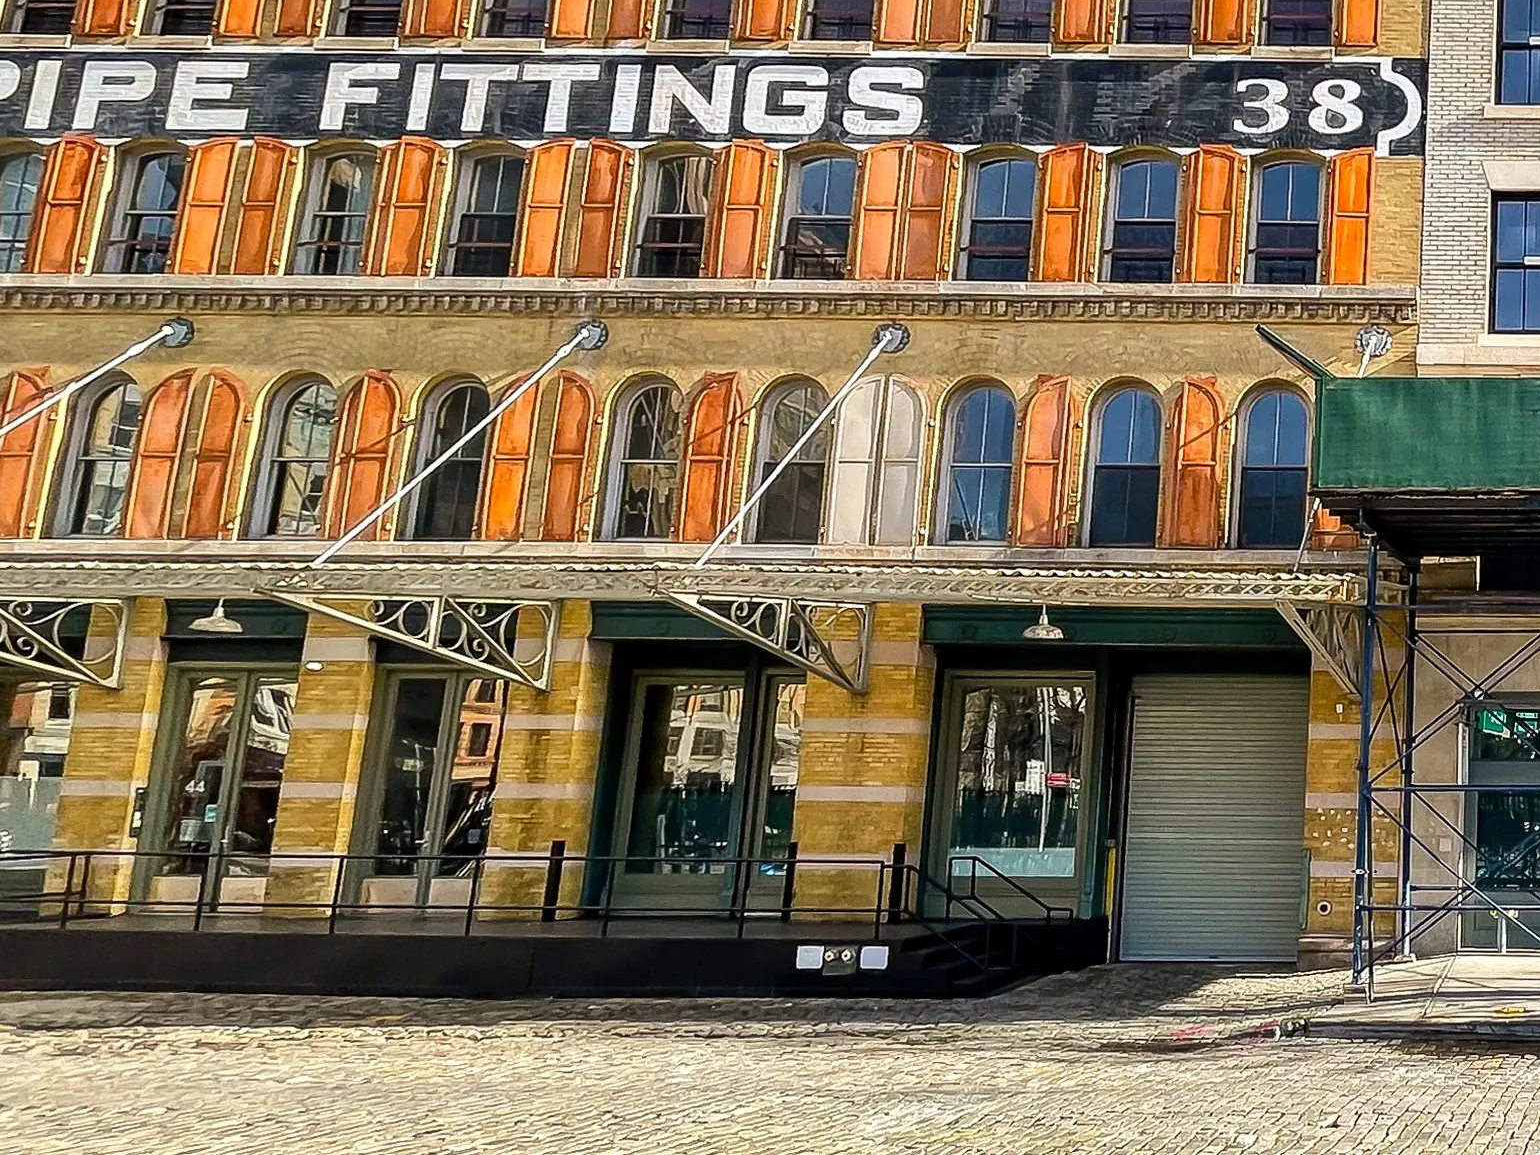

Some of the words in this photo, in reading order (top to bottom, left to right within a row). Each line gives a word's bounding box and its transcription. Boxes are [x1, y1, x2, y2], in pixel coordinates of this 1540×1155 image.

[0, 60, 250, 130] IPE
[320, 62, 923, 136] FITTINGS
[1233, 78, 1363, 134] 38
[185, 780, 205, 793] 44
